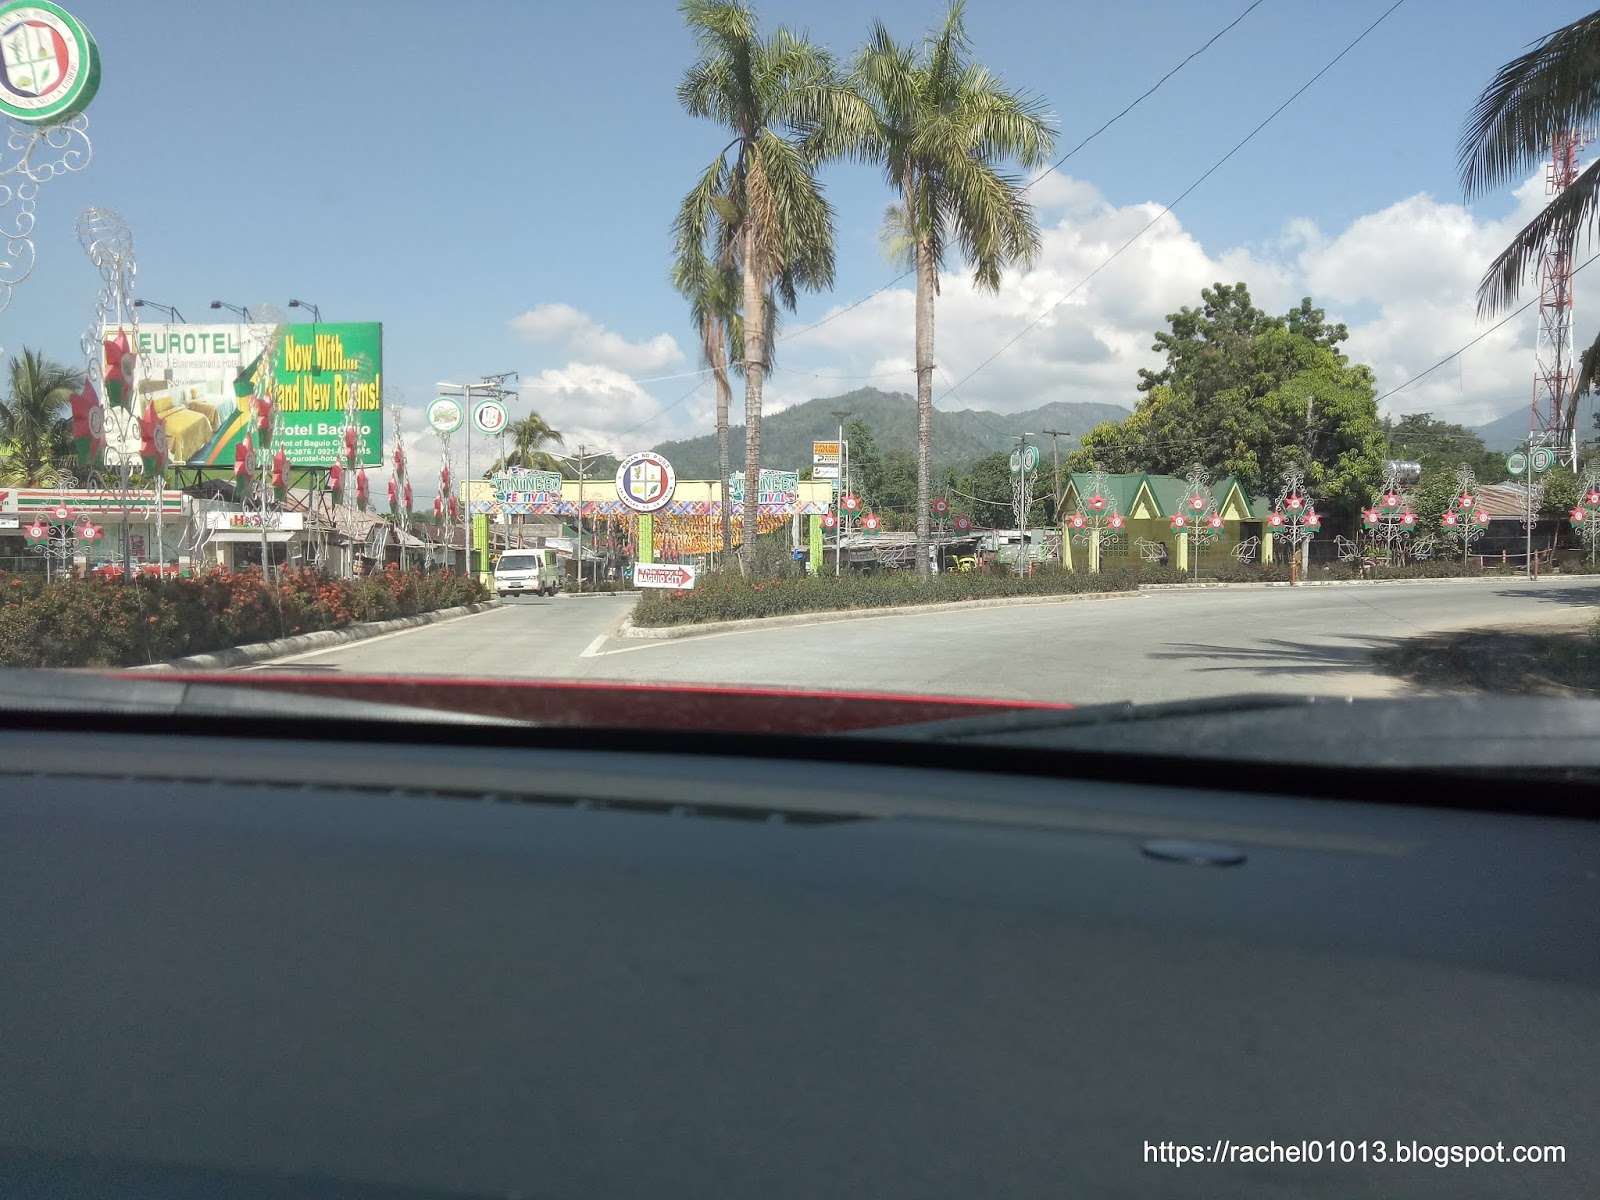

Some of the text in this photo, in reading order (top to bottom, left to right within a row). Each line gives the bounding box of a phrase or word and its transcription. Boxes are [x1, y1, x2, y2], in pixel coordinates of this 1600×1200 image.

[140, 333, 240, 354] EUROTEL
[285, 335, 313, 372] Now
[303, 374, 331, 411] New
[638, 574, 684, 584] BAGUIO CITY
